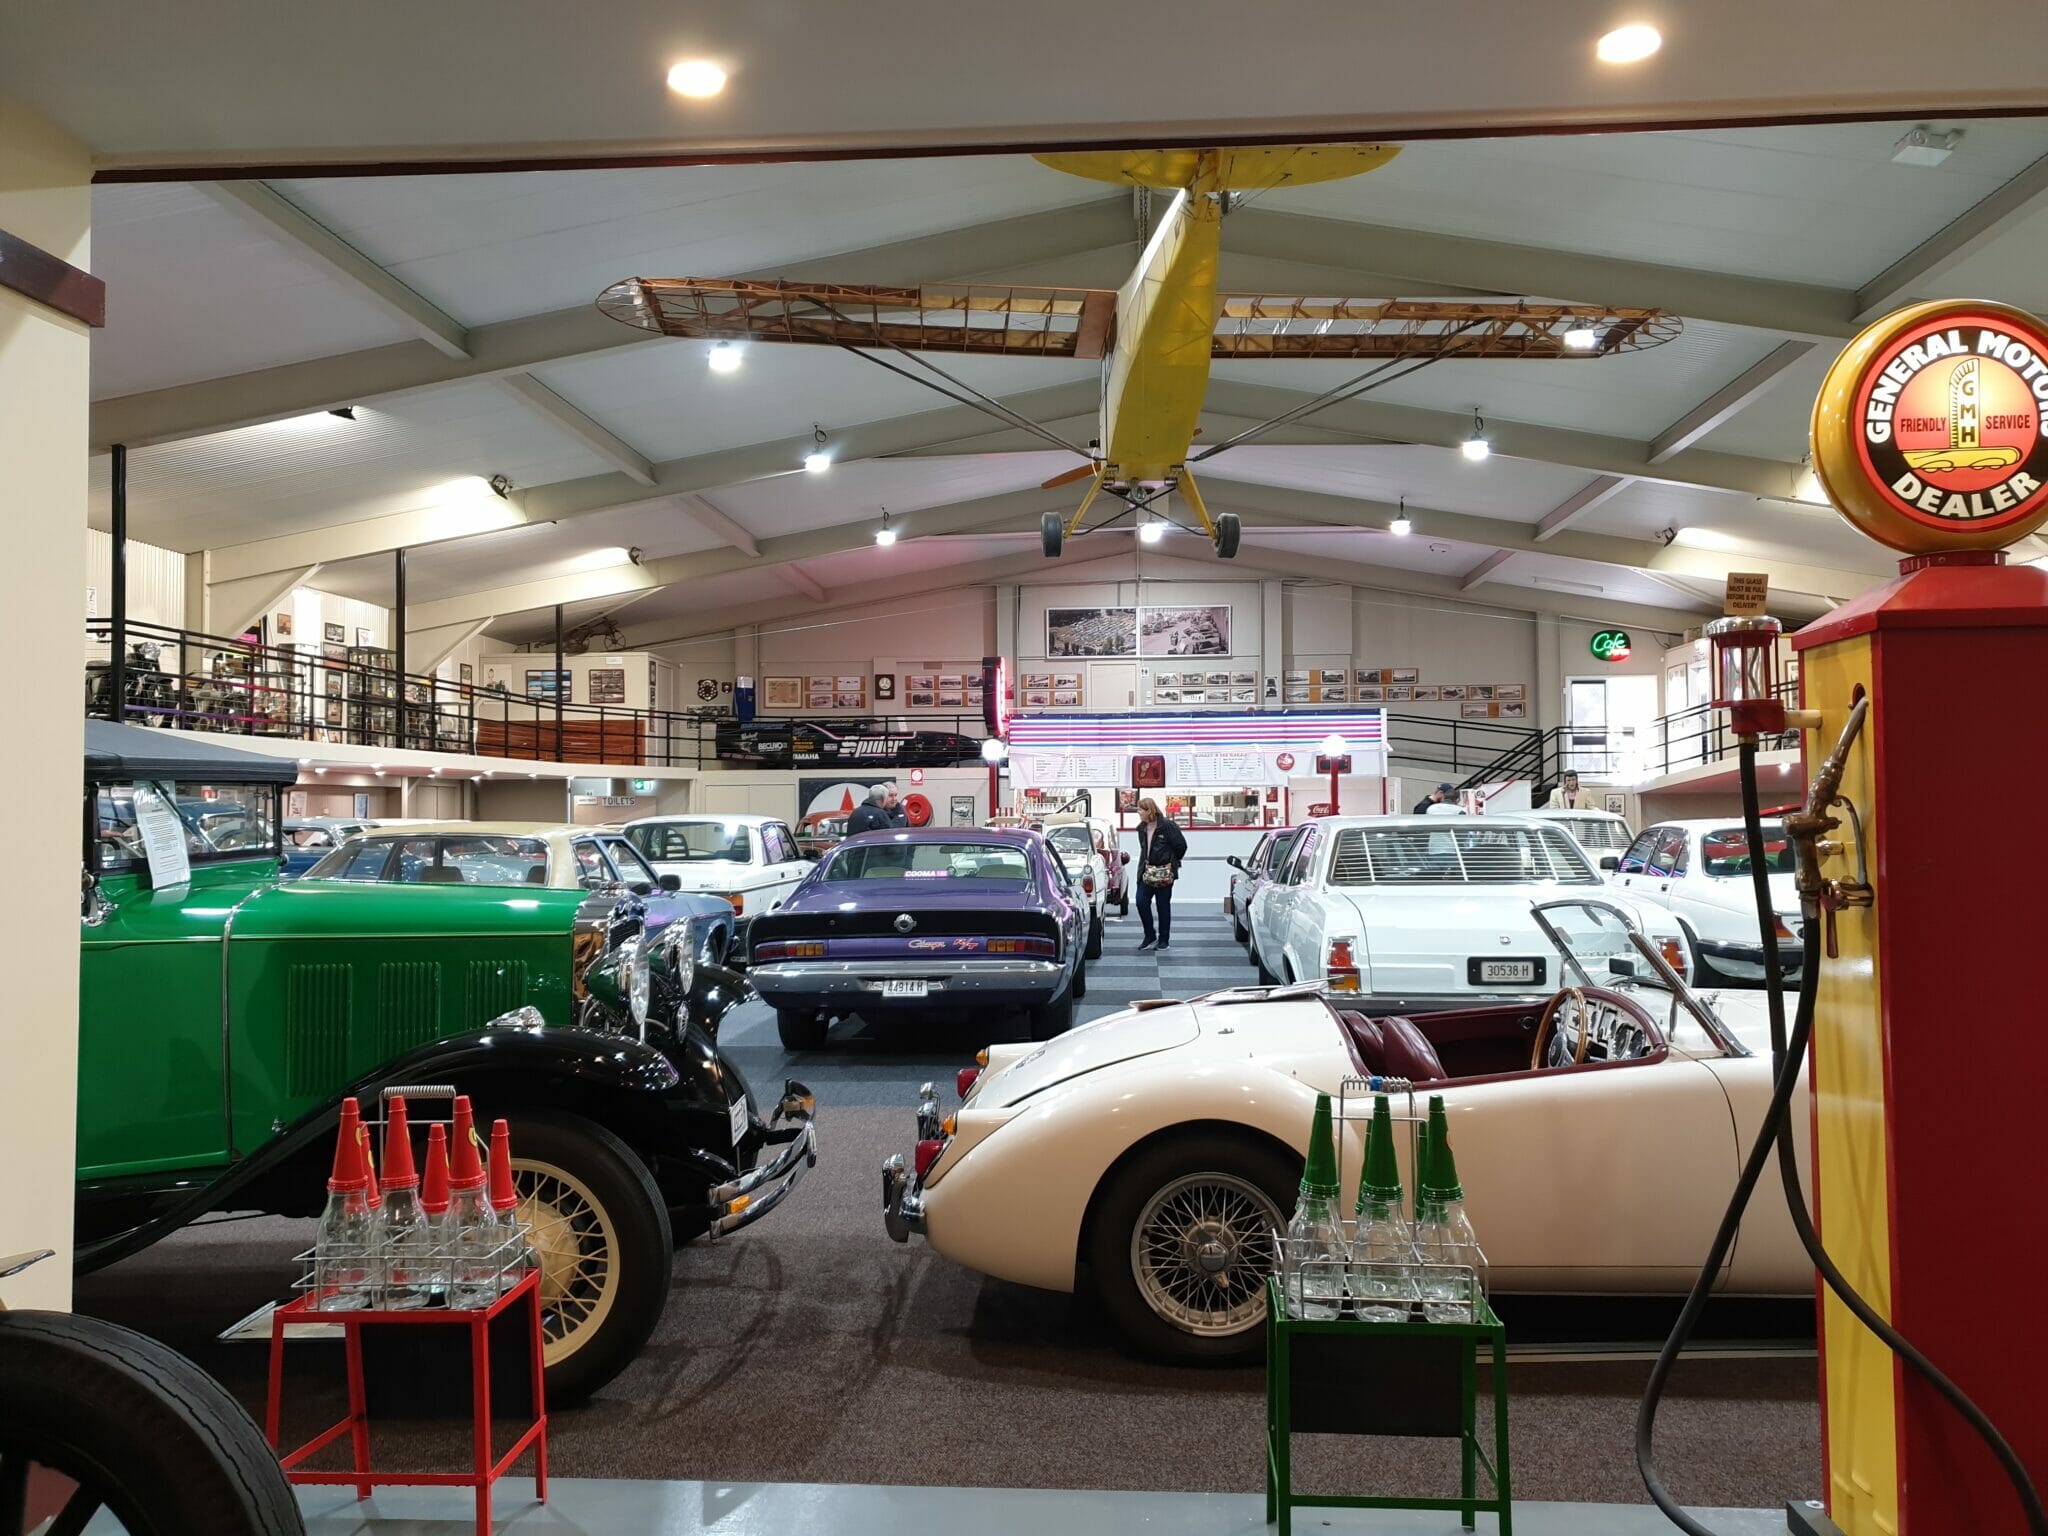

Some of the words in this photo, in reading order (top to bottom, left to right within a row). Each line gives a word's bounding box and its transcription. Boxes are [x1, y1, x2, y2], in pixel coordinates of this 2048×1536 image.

[1866, 330, 1968, 444] GENERAL
[1900, 416, 1947, 433] FRIENDLY
[1985, 414, 2031, 430] SERVICE
[1891, 471, 2041, 518] DEALER
[1593, 632, 1626, 652] Cafe
[602, 797, 635, 805] TOILETS
[905, 870, 936, 878] COOMA
[908, 939, 946, 950] Charger
[888, 981, 915, 992] 44914
